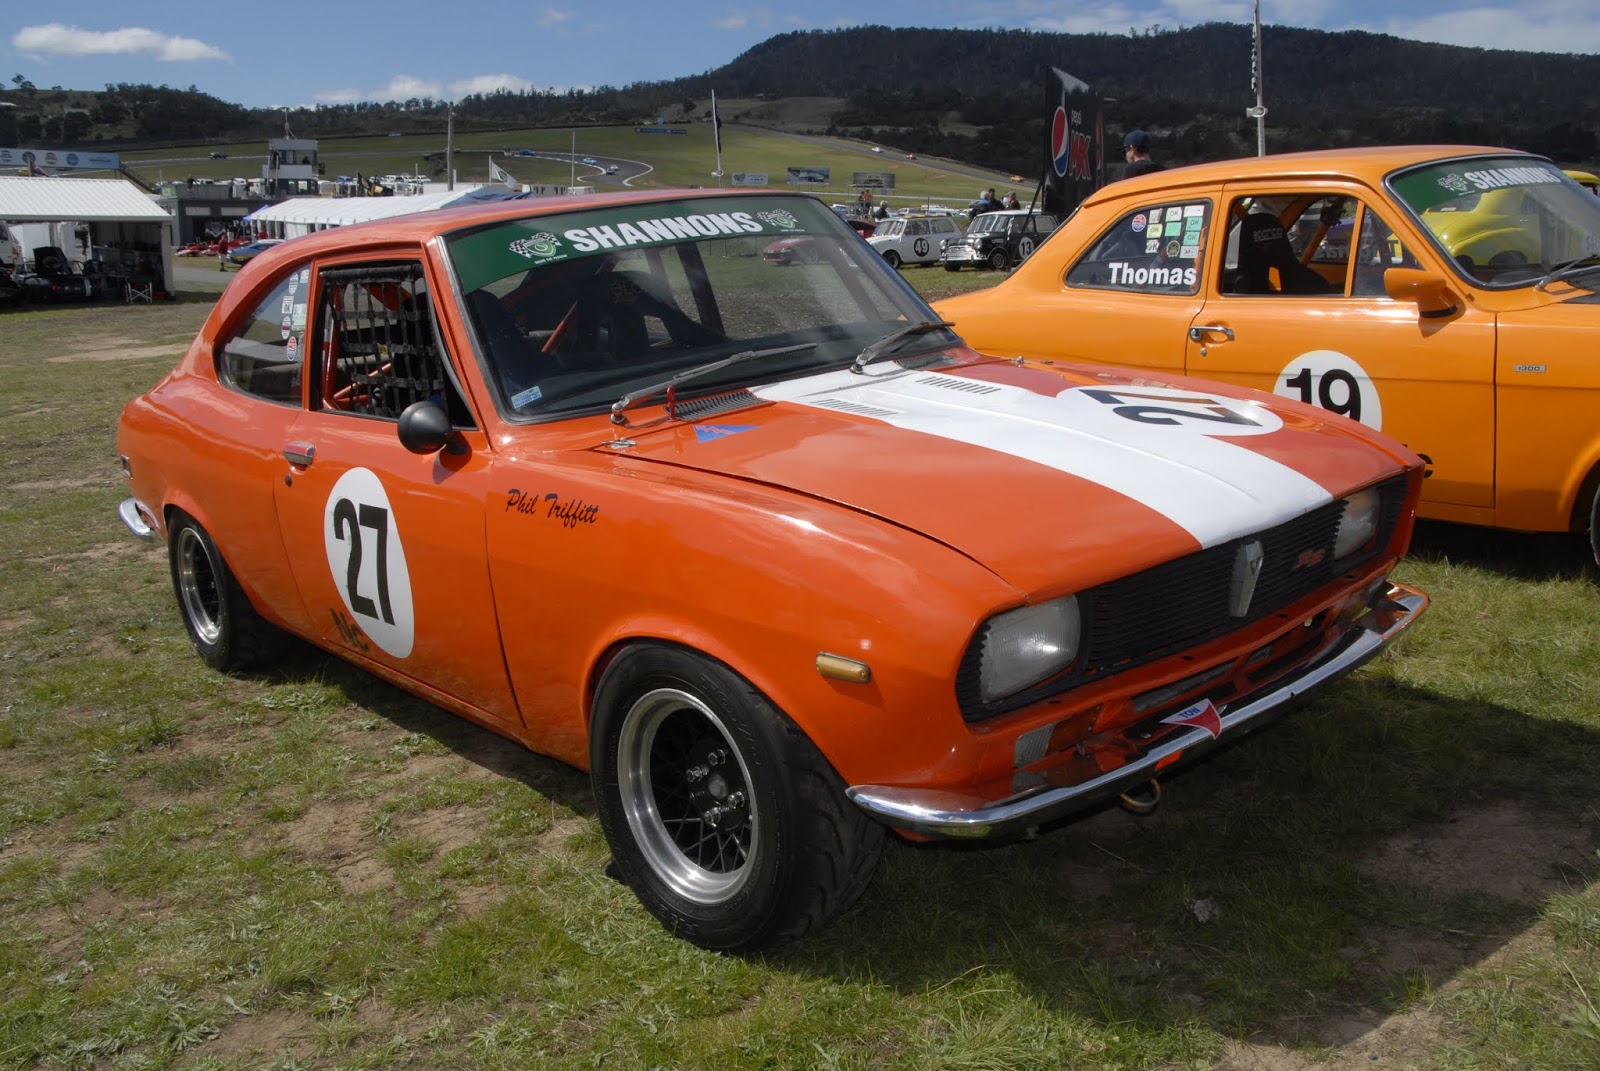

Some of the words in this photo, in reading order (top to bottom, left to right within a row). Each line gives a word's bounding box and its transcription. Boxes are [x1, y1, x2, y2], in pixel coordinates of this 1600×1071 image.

[1463, 167, 1561, 190] SHANNONS
[564, 212, 763, 252] SHANNONS
[914, 241, 929, 255] 49
[1021, 240, 1032, 255] 13
[1108, 262, 1197, 286] Thomas
[1285, 367, 1362, 422] 19
[505, 488, 539, 515] Phil
[544, 493, 600, 528] Triffitt
[333, 497, 396, 627] 27
[1177, 706, 1201, 718] TOW
